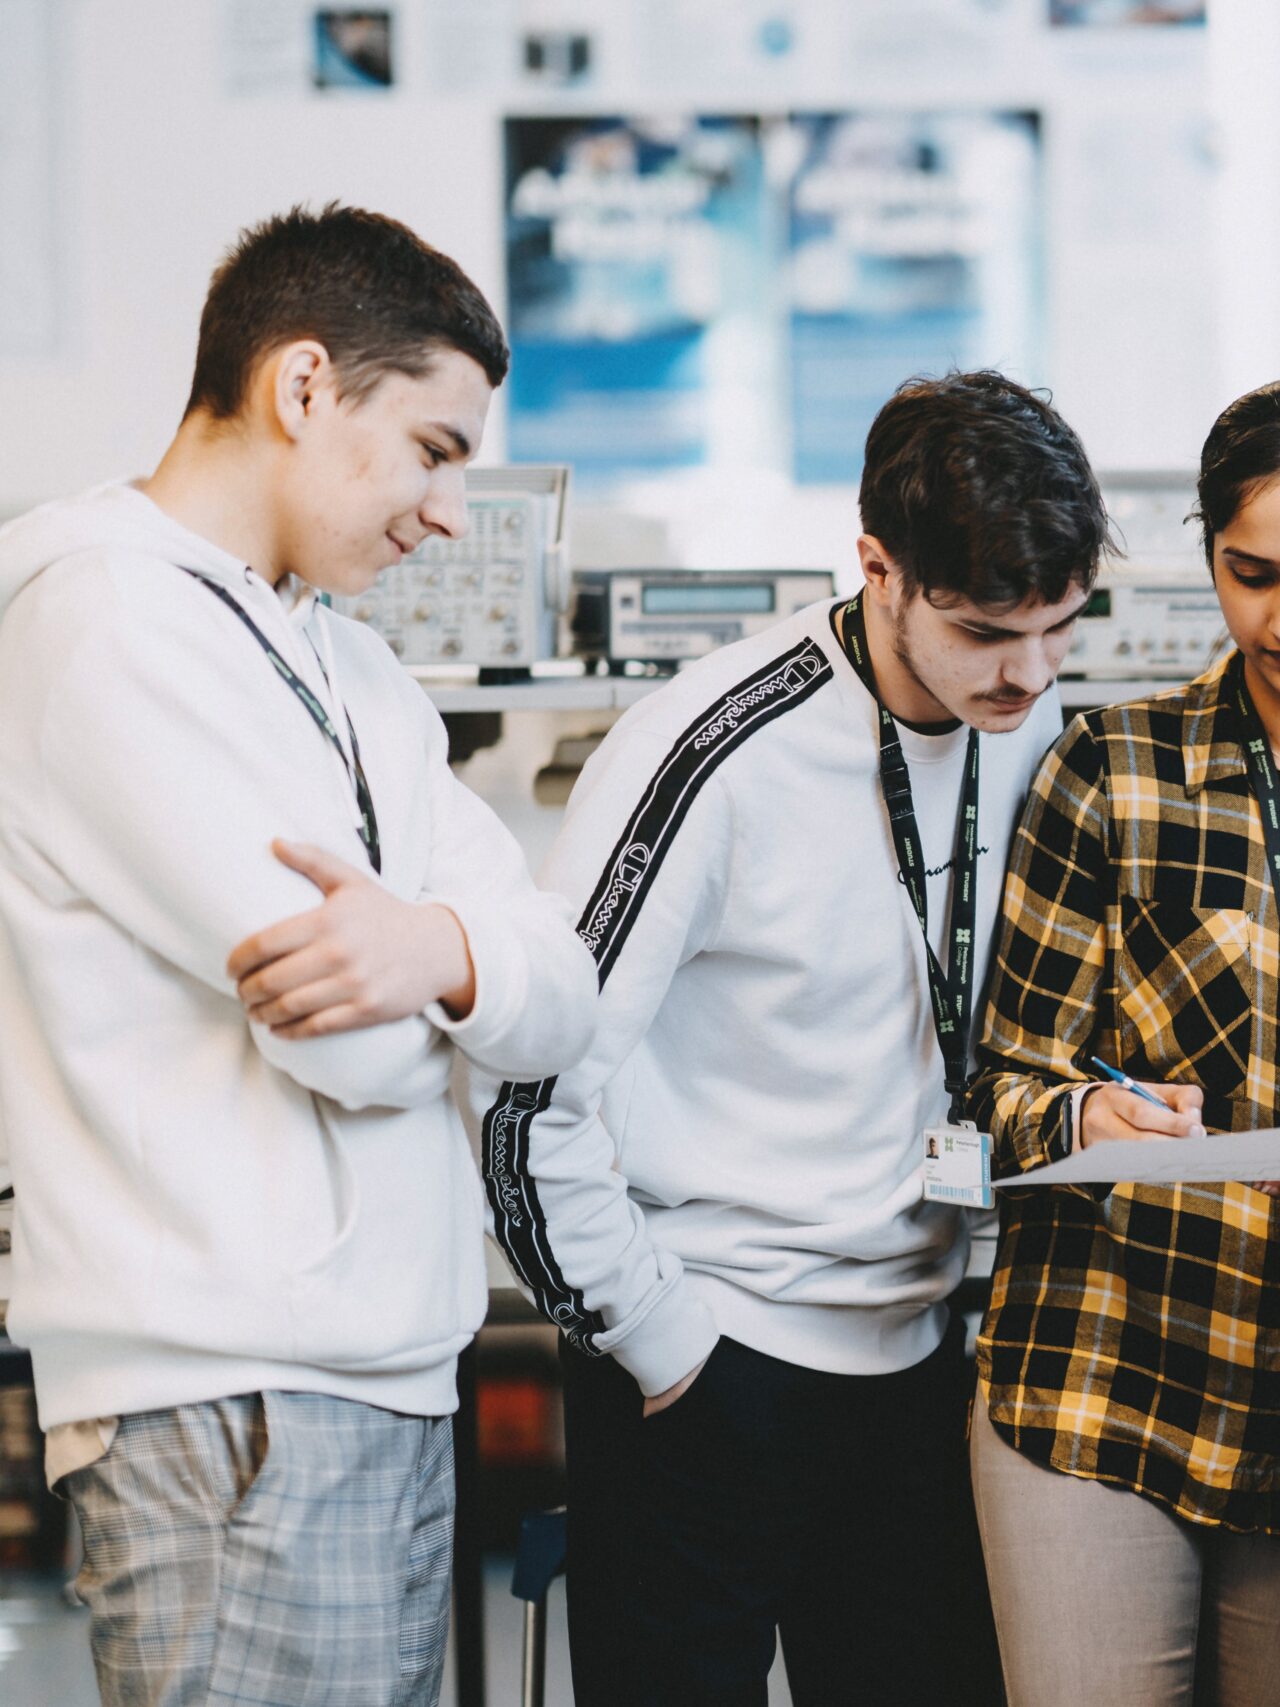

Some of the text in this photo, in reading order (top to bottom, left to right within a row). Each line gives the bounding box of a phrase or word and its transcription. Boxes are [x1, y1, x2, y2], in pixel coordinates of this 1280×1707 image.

[1261, 754, 1274, 789] Peterborough
[1268, 799, 1279, 830] STUDENT
[904, 837, 915, 867] STUDENT
[579, 842, 651, 953] Champ
[962, 871, 970, 902] STUDENT
[960, 946, 969, 984] Peterborough
